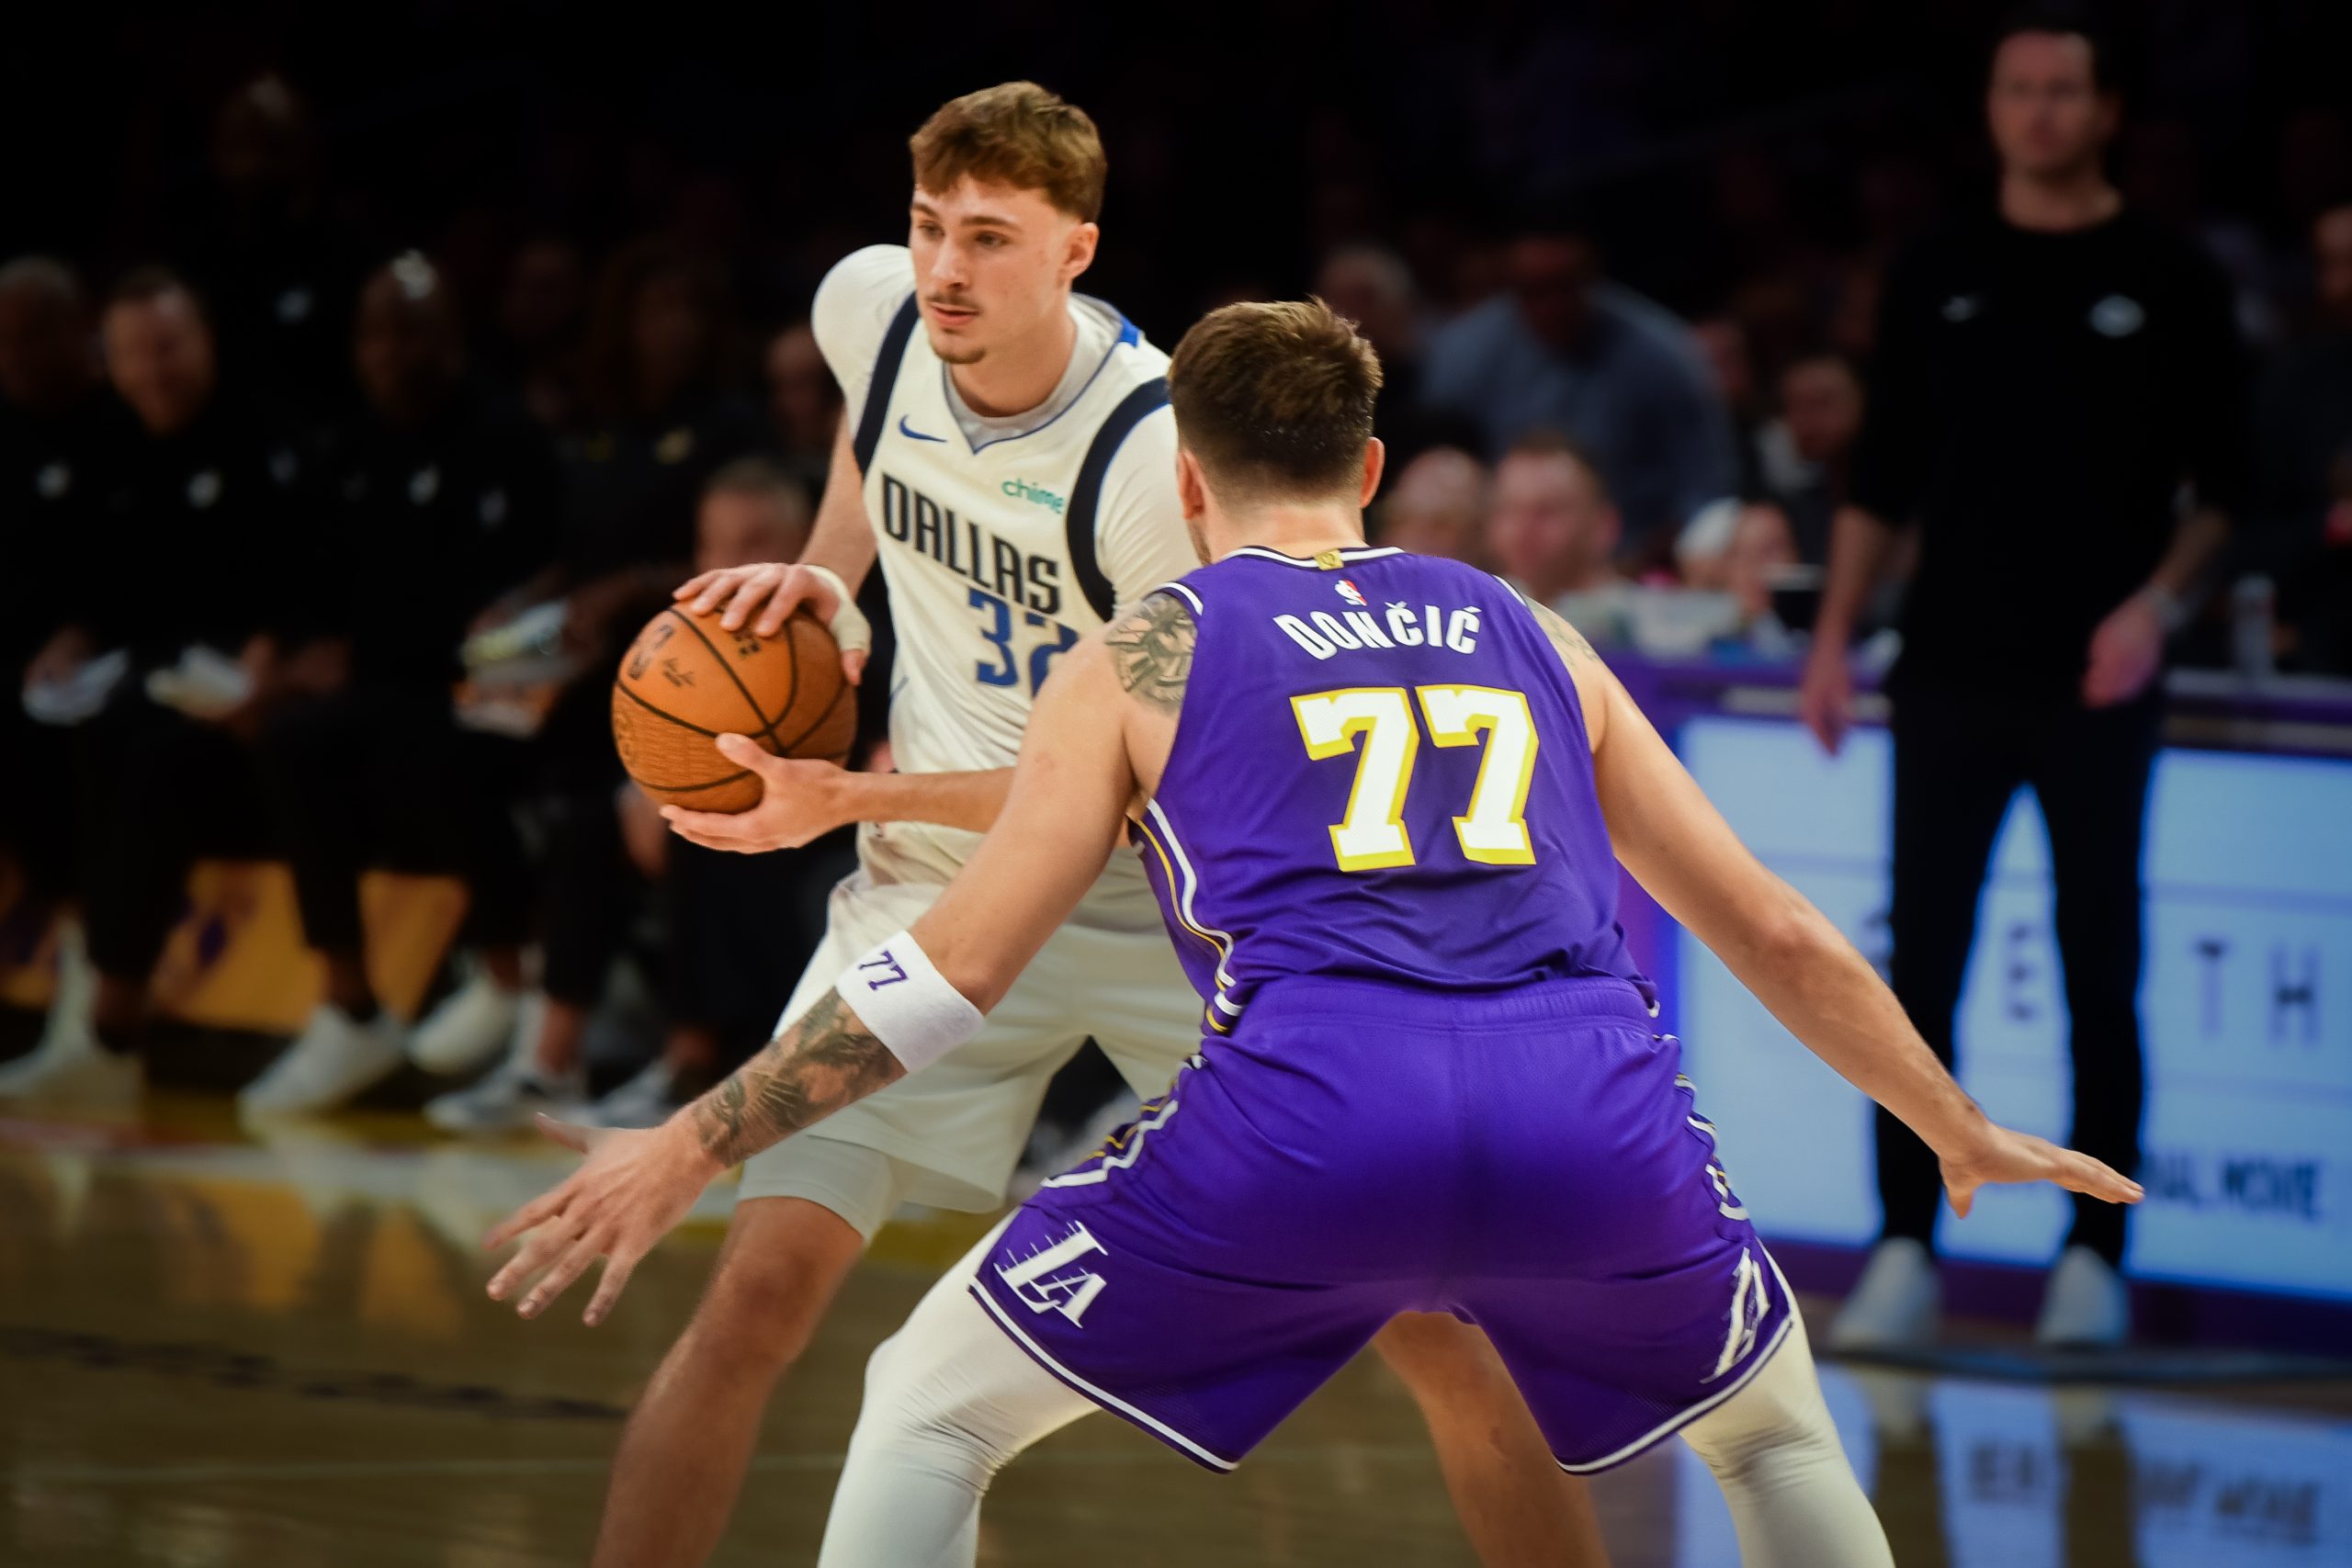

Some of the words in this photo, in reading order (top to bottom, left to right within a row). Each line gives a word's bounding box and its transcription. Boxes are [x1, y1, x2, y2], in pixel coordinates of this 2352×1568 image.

[1001, 477, 1064, 514] chime
[880, 471, 1060, 615] DALLAS
[1272, 601, 1482, 660] DONČIĆ
[1289, 683, 1540, 873] 77
[857, 949, 910, 992] 77
[993, 1219, 1108, 1330] LA
